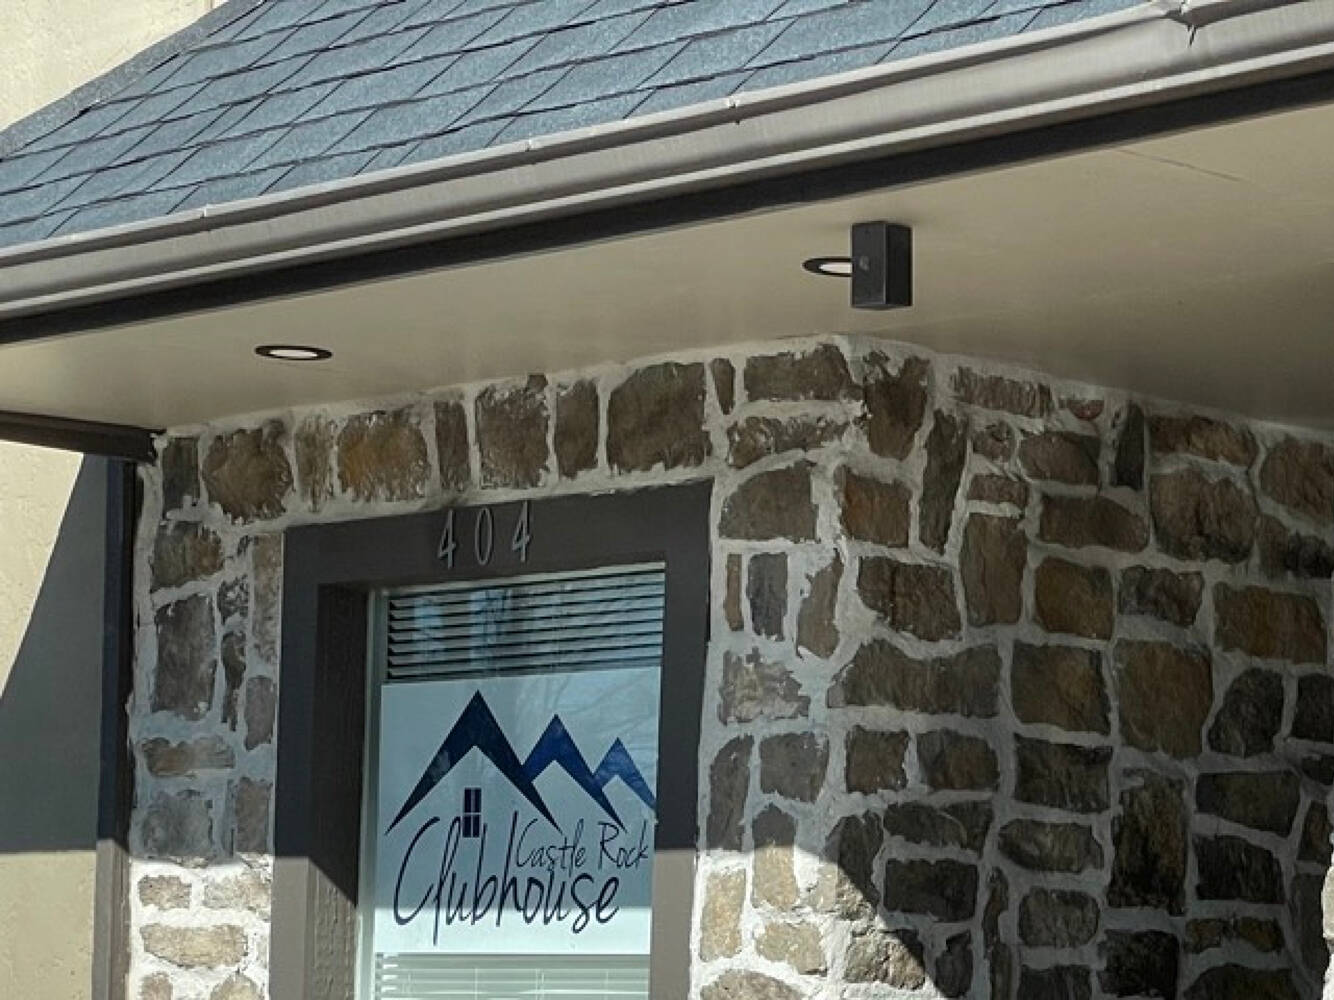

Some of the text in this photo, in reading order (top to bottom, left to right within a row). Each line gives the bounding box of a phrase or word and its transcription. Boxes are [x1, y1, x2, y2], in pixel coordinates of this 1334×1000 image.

[393, 810, 620, 946] Clubhouse
[516, 818, 649, 877] Castle Rock
